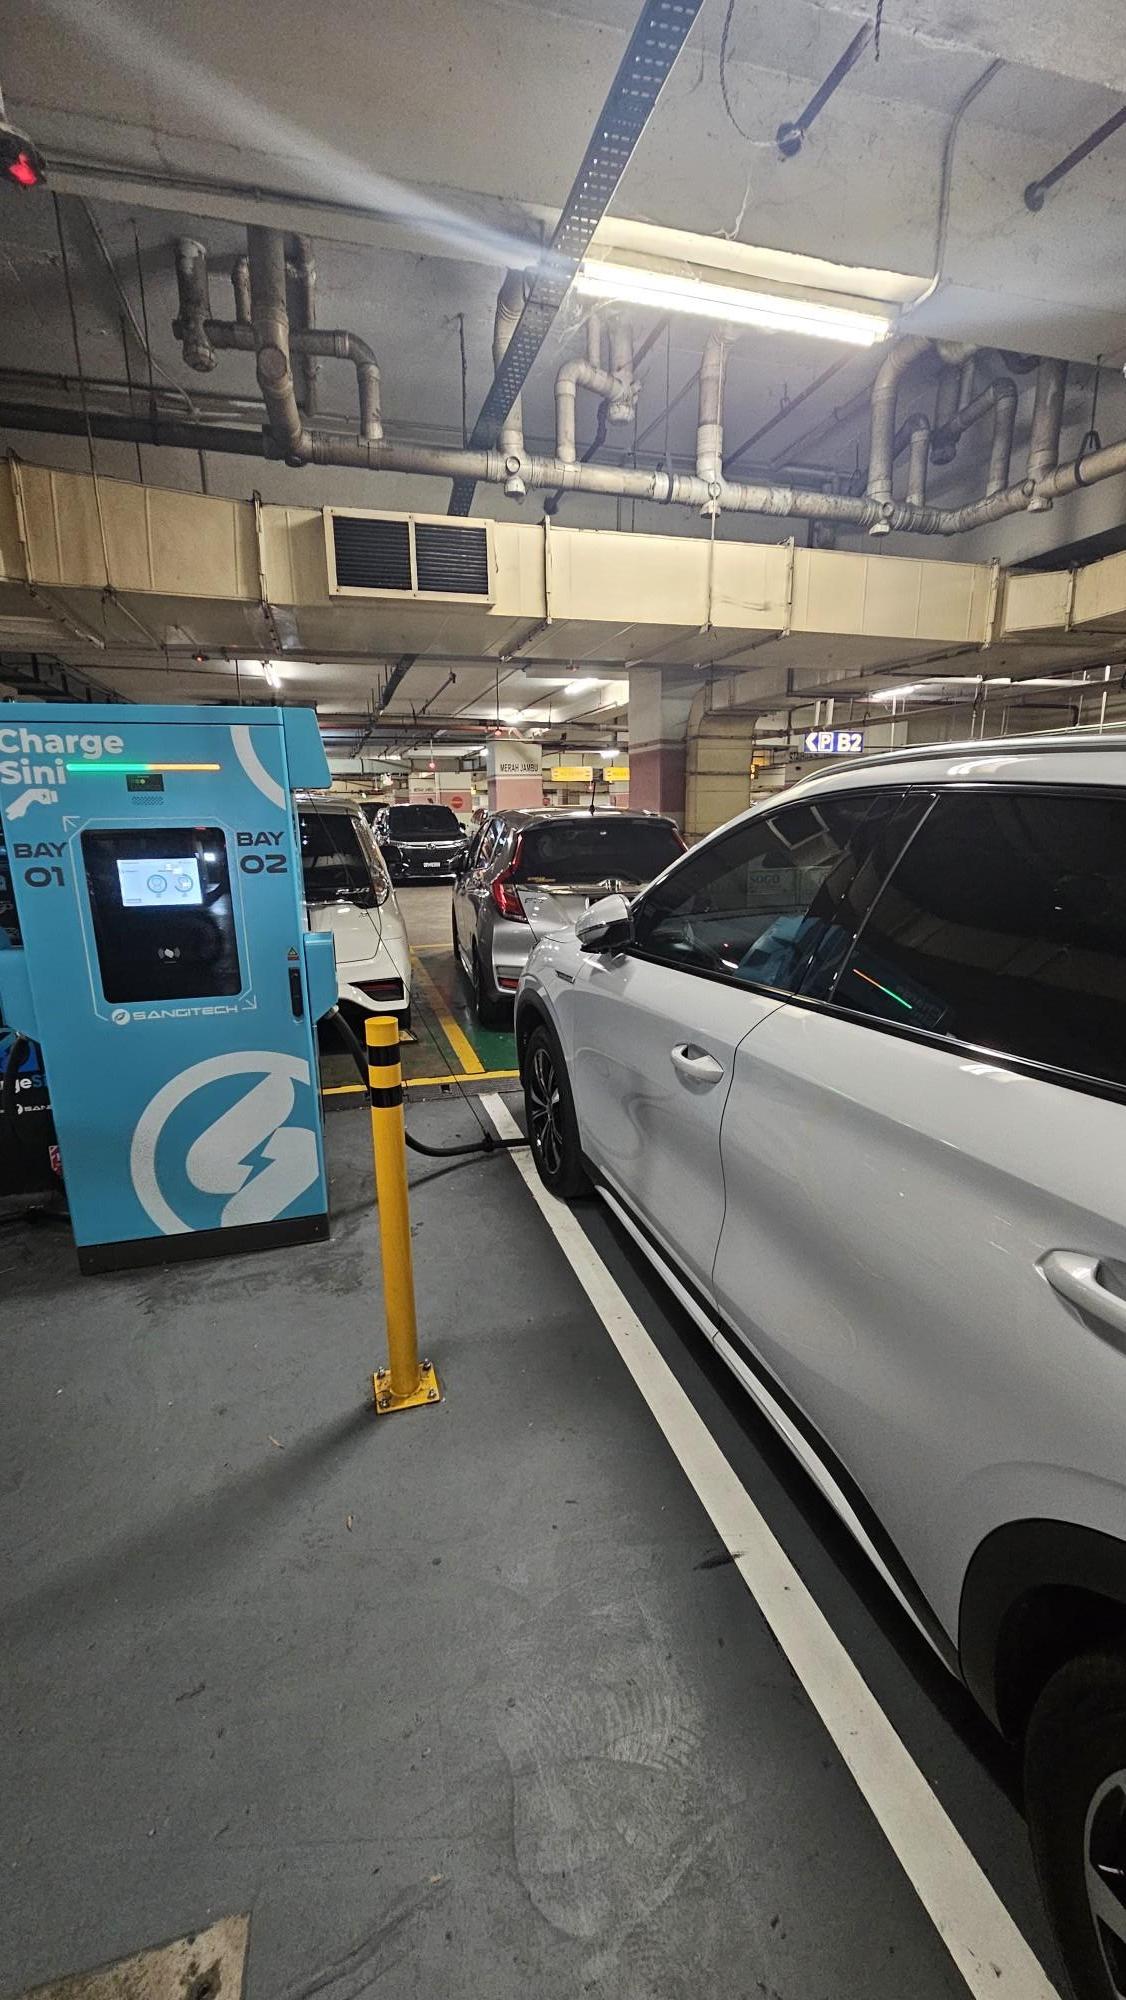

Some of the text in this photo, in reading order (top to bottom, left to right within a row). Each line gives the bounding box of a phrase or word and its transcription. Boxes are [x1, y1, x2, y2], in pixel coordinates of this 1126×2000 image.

[0, 728, 124, 759] Charge
[837, 733, 862, 752] B2
[0, 758, 67, 785] Sini
[500, 763, 519, 772] MERAH
[236, 831, 285, 847] BAY
[13, 842, 67, 859] BAY
[132, 1005, 239, 1020] SANGITECH
